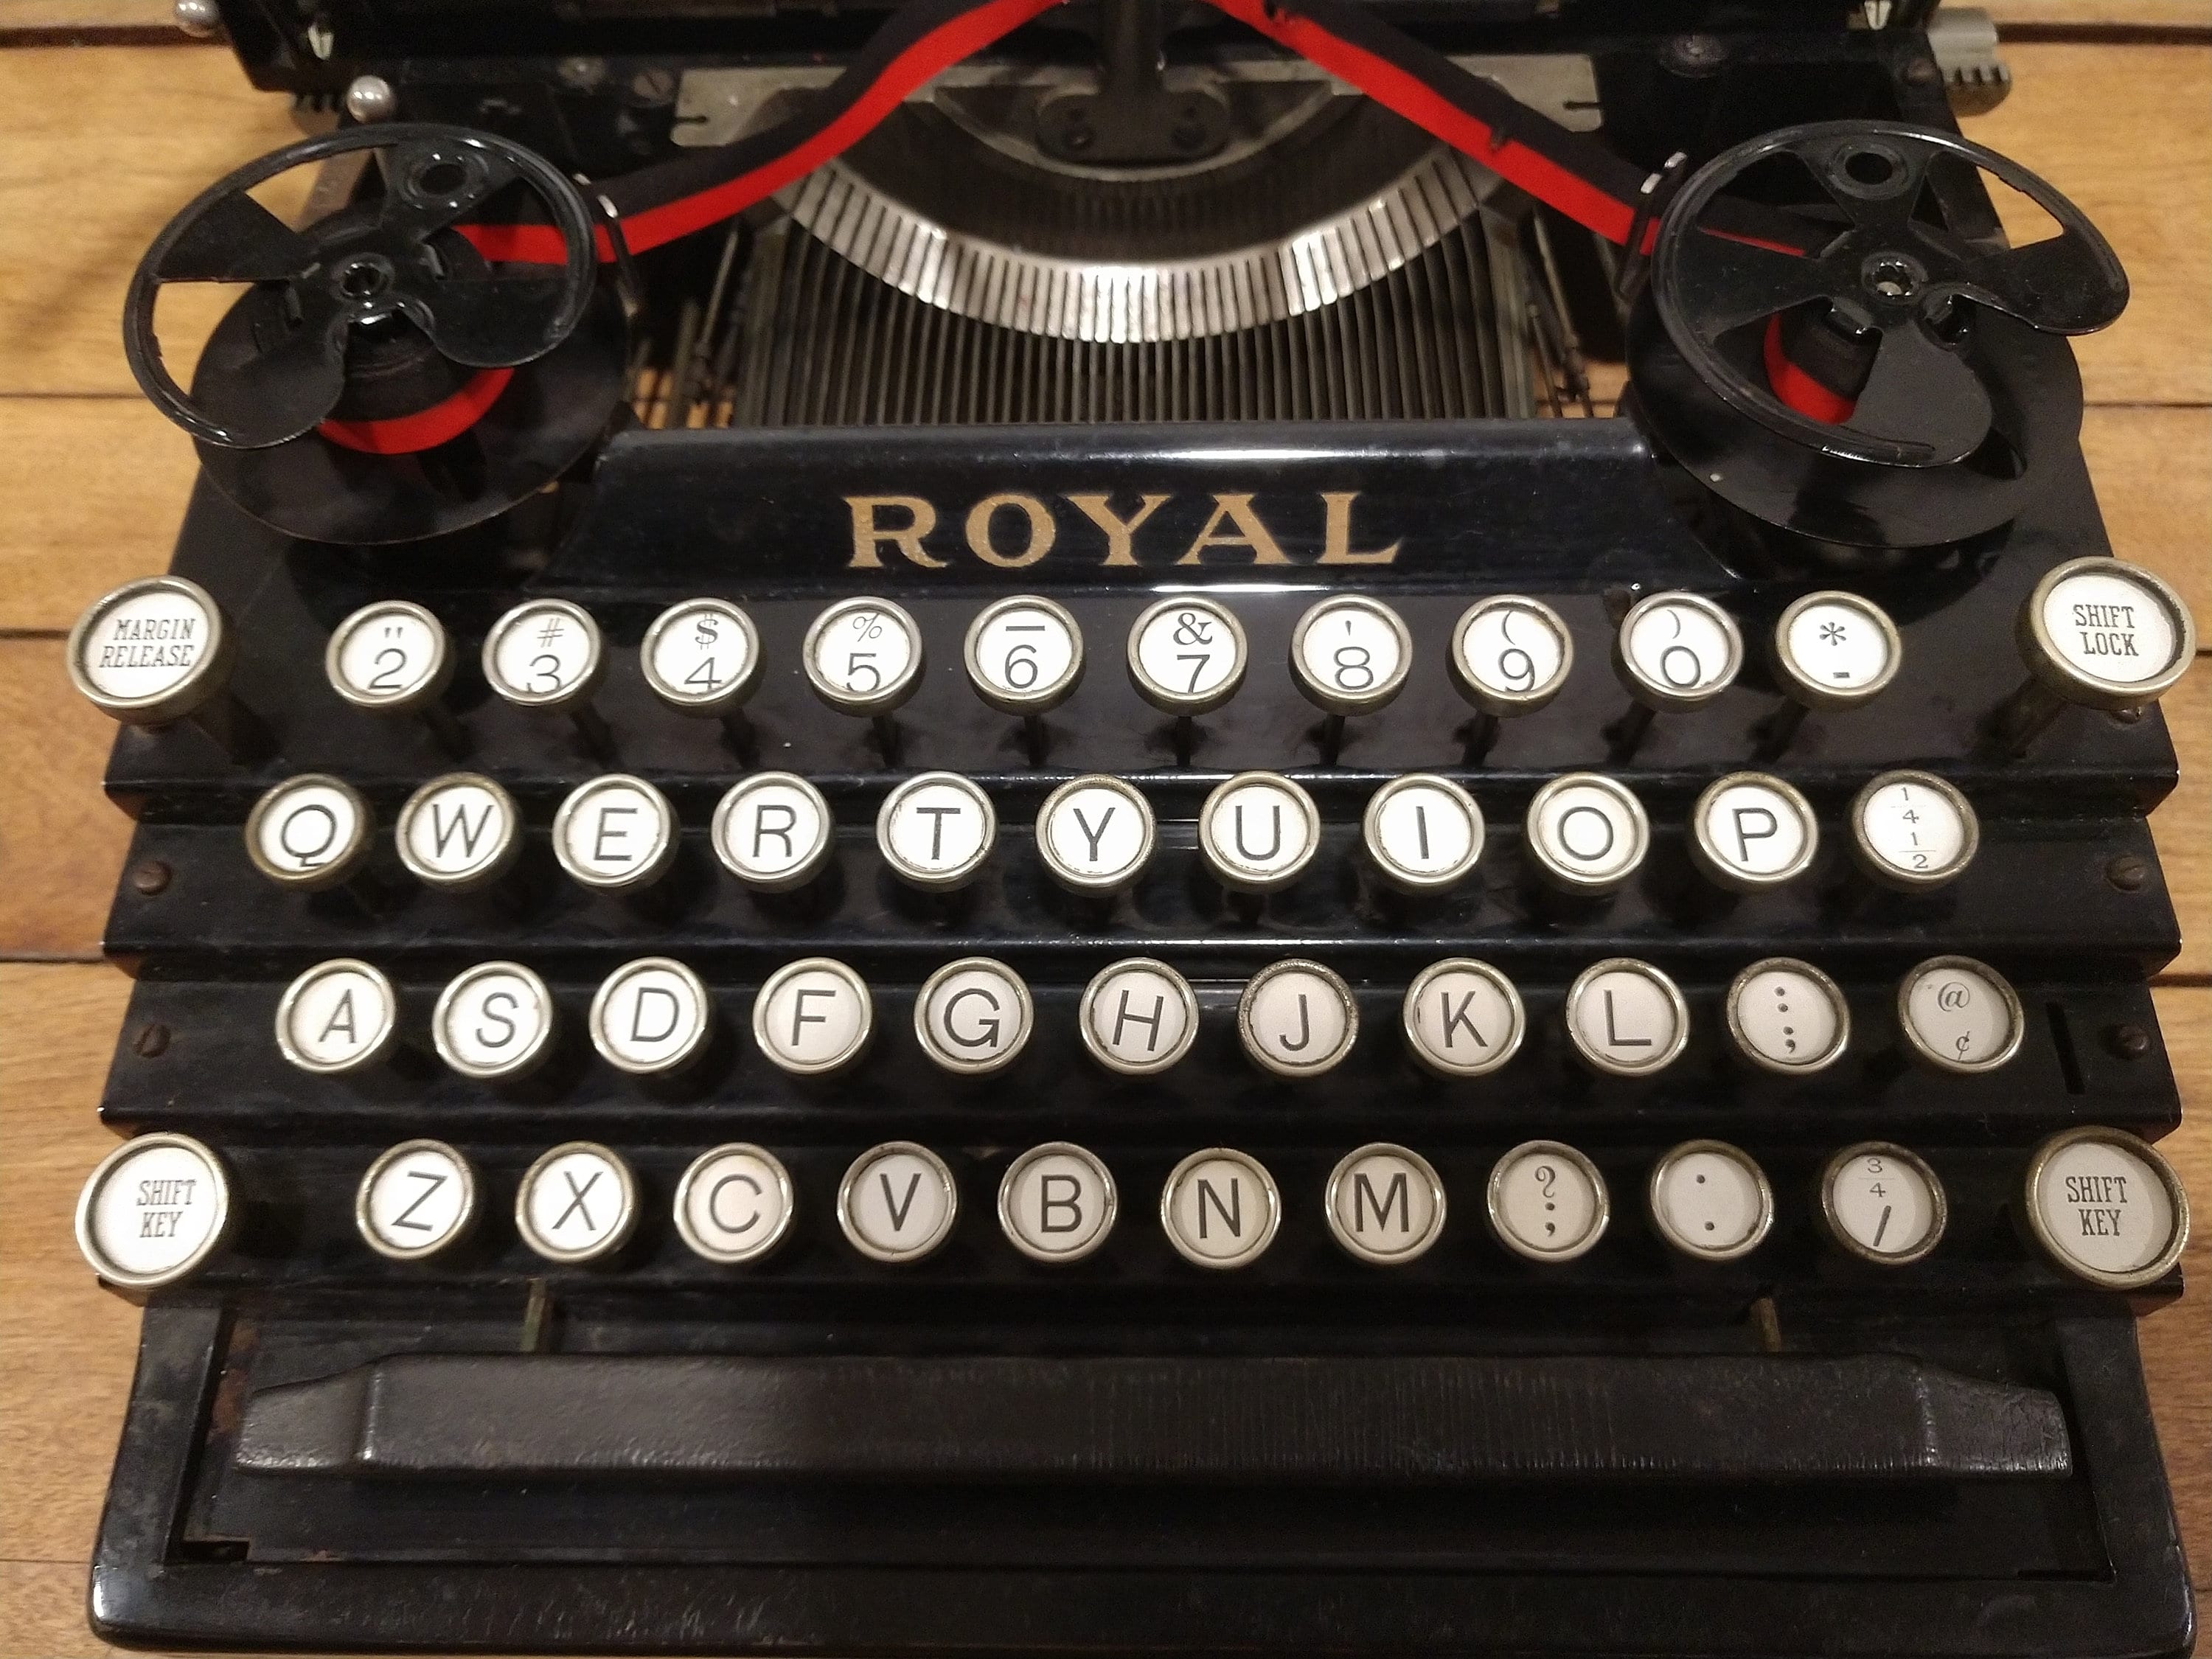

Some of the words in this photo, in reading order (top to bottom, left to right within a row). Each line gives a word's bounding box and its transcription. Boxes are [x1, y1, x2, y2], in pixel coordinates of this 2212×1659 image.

[842, 491, 1402, 569] ROYAL
[114, 618, 197, 643] MARGIN
[538, 618, 564, 647] #
[694, 613, 720, 650] $
[852, 613, 882, 642] %
[1172, 613, 1213, 645] &
[2073, 603, 2136, 630] SHIFT
[98, 644, 195, 668] RELEASE
[368, 648, 408, 689] 2
[1005, 644, 1037, 689] 6
[1334, 647, 1374, 689] 8
[2081, 630, 2140, 657] LOCK
[526, 655, 562, 692] 3
[684, 657, 722, 691] 4
[846, 653, 880, 691] 5
[1176, 654, 1211, 693] 7
[1498, 649, 1535, 692] 9
[281, 804, 338, 868] Q
[431, 804, 494, 858] W
[594, 807, 638, 861] E
[753, 805, 796, 857] R
[917, 807, 961, 860] T
[1074, 807, 1116, 861] Y
[1236, 805, 1281, 860] U
[1416, 807, 1429, 859] I
[1557, 807, 1614, 861] O
[1733, 808, 1778, 861] P
[319, 989, 356, 1043] A
[476, 992, 518, 1048] S
[630, 987, 679, 1042] D
[791, 990, 836, 1046] F
[943, 988, 1000, 1048] G
[1113, 990, 1164, 1051] H
[1279, 995, 1310, 1051] J
[1441, 991, 1488, 1048] K
[1605, 990, 1652, 1046] L
[1938, 982, 1970, 1012] @
[136, 1180, 196, 1206] SHIFT
[392, 1172, 447, 1231] Z
[552, 1172, 602, 1231] X
[709, 1174, 762, 1234] C
[880, 1173, 921, 1231] V
[1041, 1175, 1082, 1233] B
[1197, 1178, 1240, 1239] N
[1354, 1173, 1409, 1232] M
[2065, 1175, 2126, 1203] SHIFT
[139, 1211, 181, 1239] KEY
[2079, 1208, 2121, 1237] KEY
